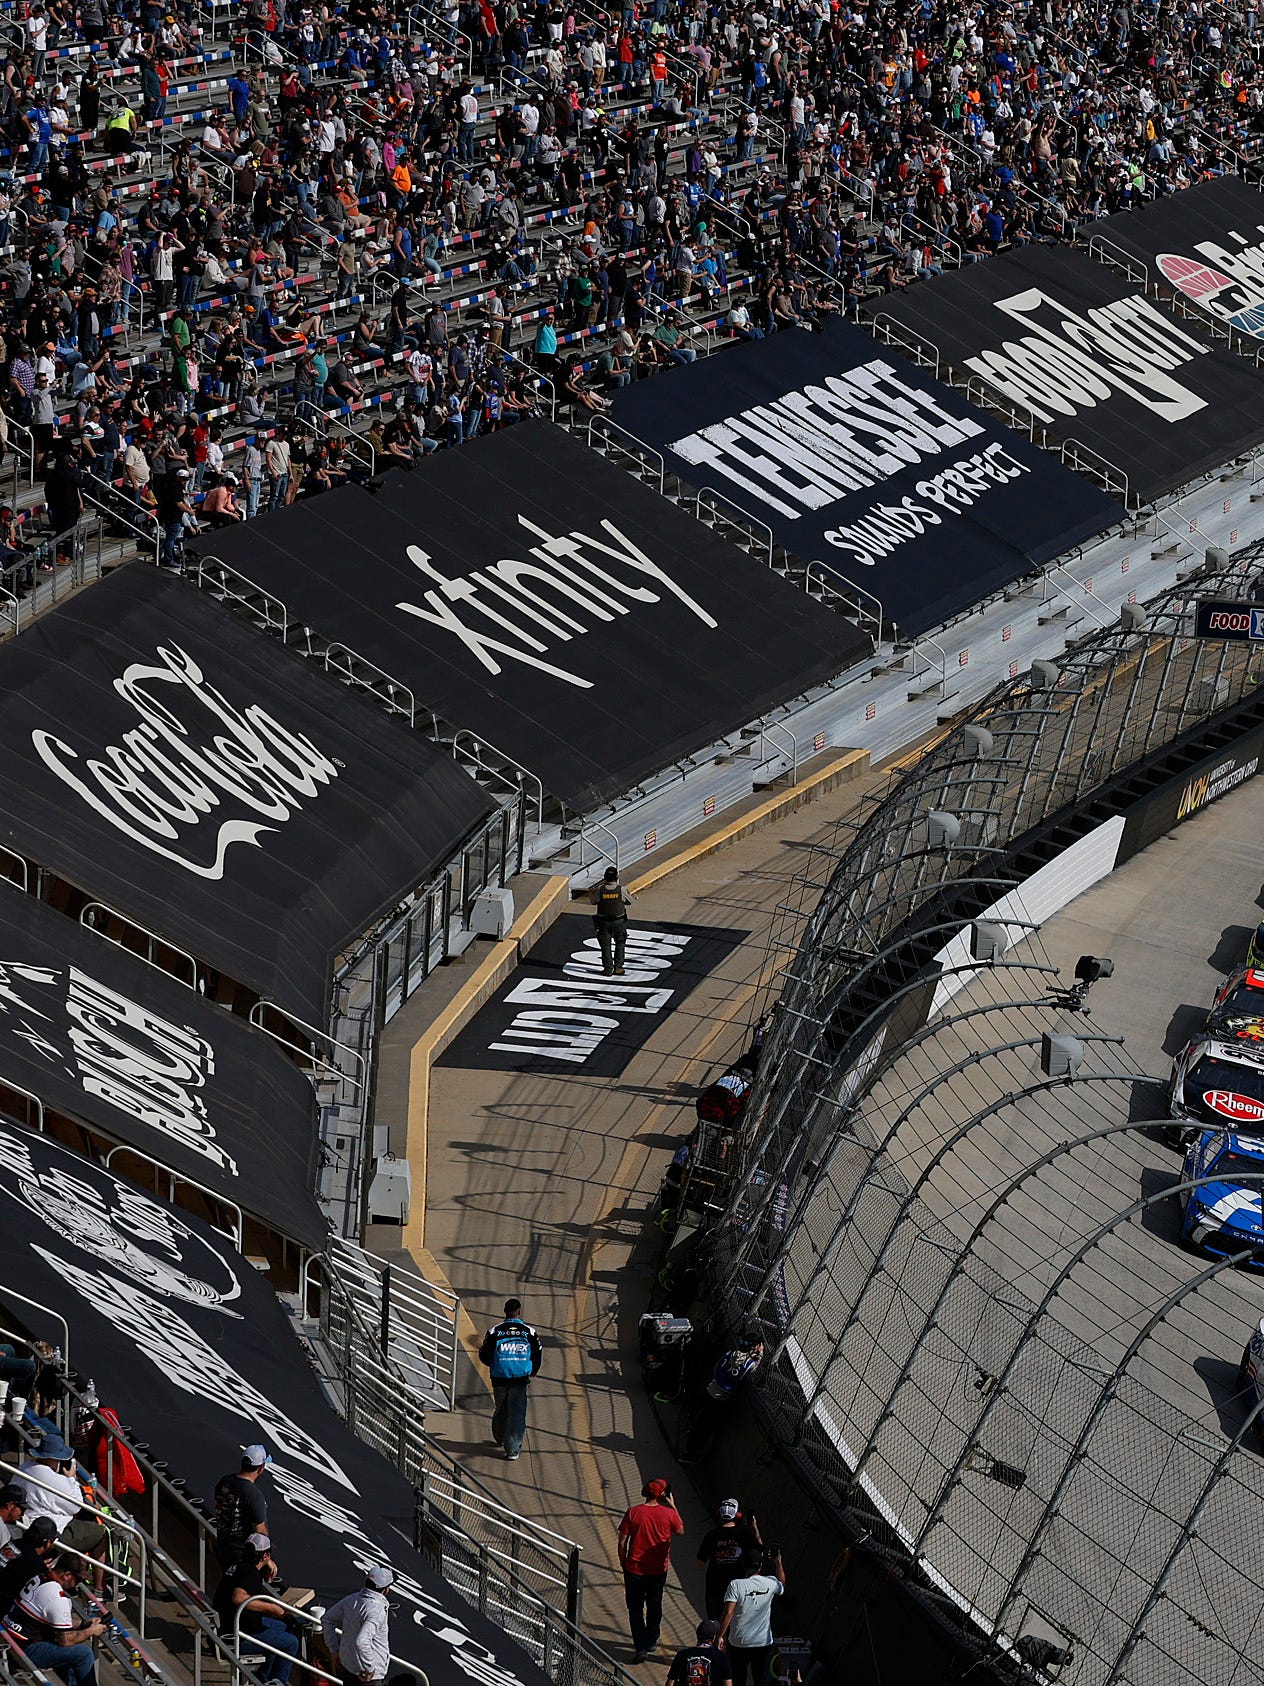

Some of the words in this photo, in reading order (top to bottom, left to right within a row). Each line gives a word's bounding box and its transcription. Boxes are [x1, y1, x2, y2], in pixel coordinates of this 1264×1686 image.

[961, 335, 1111, 423] FOOD
[1087, 294, 1210, 376] CITY
[664, 358, 987, 519] TENNESSEE
[822, 490, 941, 567] SOUNDS
[916, 442, 1033, 517] PERFECT
[395, 513, 719, 689] xfinity
[1210, 612, 1250, 631] FOOD
[32, 638, 342, 881] Coca-Cola
[562, 928, 693, 983] FOOD
[66, 964, 239, 1177] BUSCH
[487, 1010, 620, 1063] CITY
